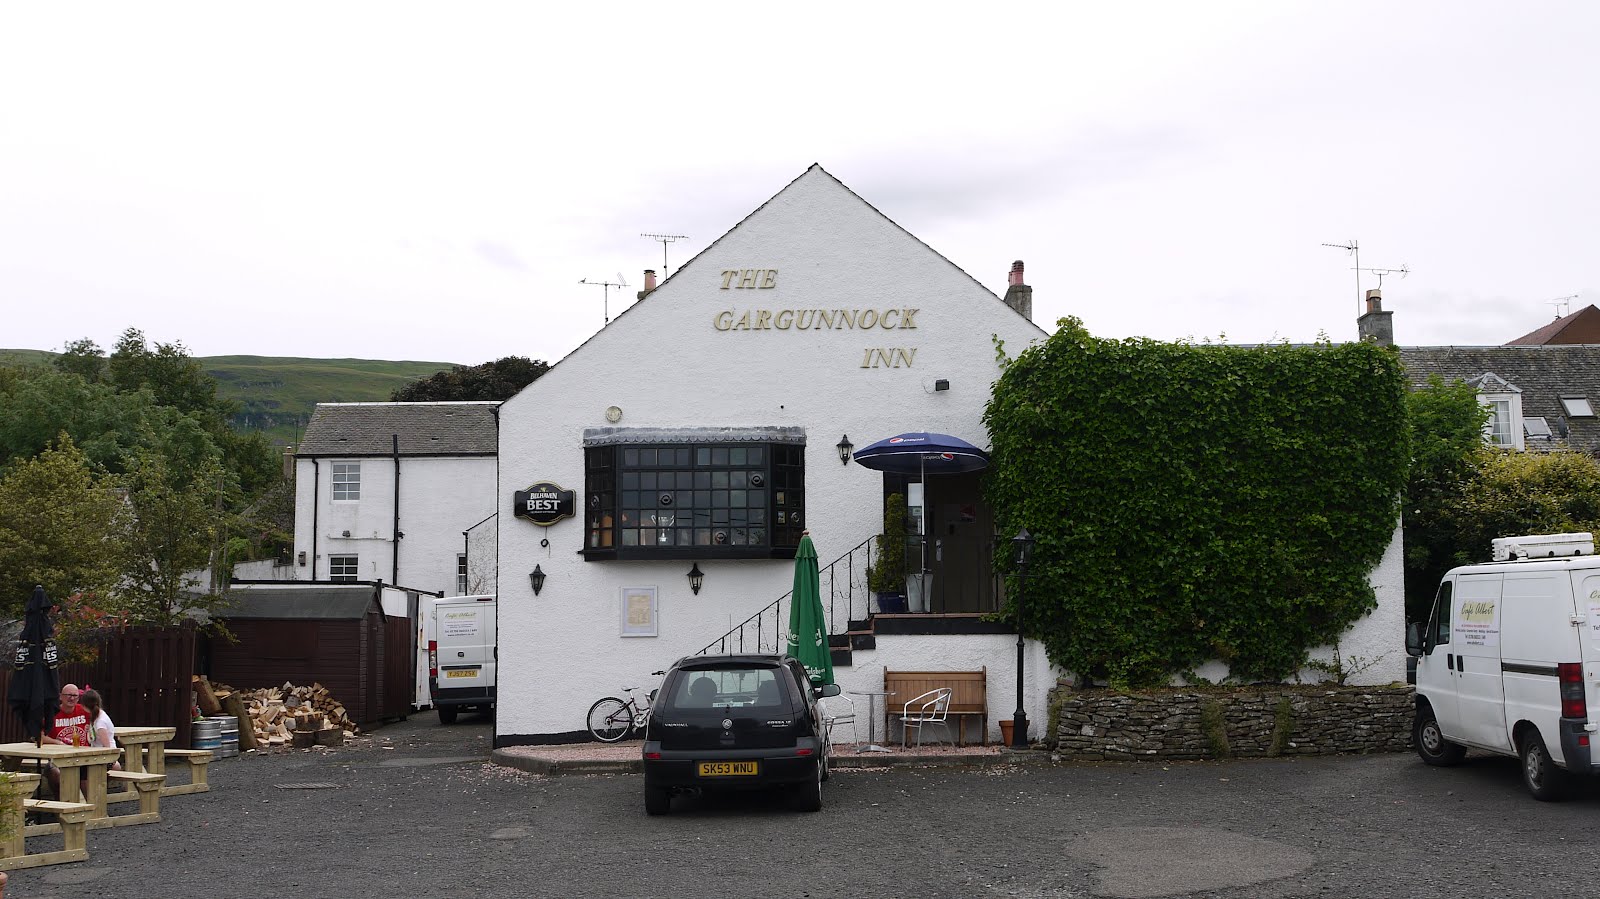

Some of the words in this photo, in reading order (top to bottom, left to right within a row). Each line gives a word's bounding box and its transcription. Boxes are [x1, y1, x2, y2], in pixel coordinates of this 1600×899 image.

[720, 269, 778, 290] THE
[713, 308, 920, 331] GARGUNNOCK
[860, 348, 917, 368] INN
[526, 500, 561, 510] BEST
[55, 715, 86, 727] RAMONES
[703, 763, 731, 774] SK53
[733, 763, 754, 774] WNU
